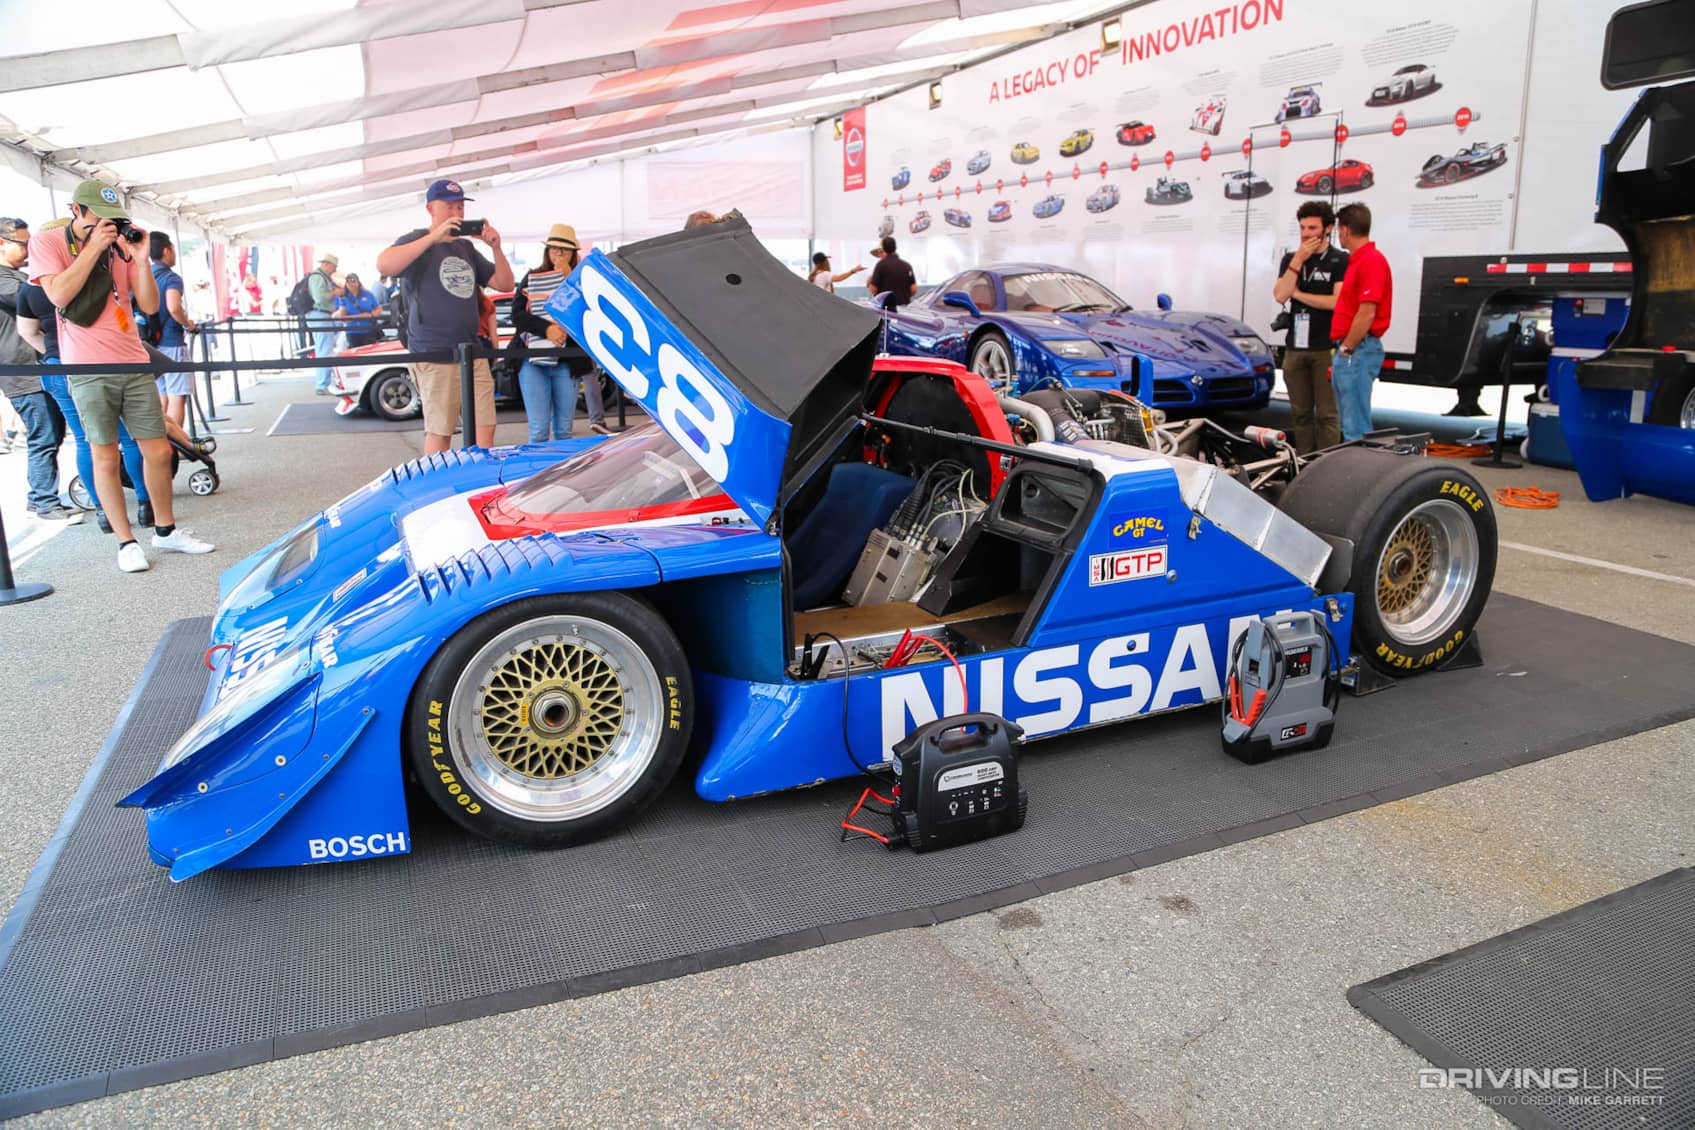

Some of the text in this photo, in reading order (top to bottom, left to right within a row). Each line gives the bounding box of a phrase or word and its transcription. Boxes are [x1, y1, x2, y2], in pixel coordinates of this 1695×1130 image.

[989, 0, 1284, 104] A LEGACY OF INNOVATION
[580, 264, 736, 484] 83
[1440, 480, 1484, 513] EAGLE
[1113, 516, 1164, 537] CAMEL
[1132, 528, 1146, 538] GT
[1115, 552, 1163, 577] GTP
[665, 675, 681, 731] EAGLE
[308, 832, 407, 859] BOSCH
